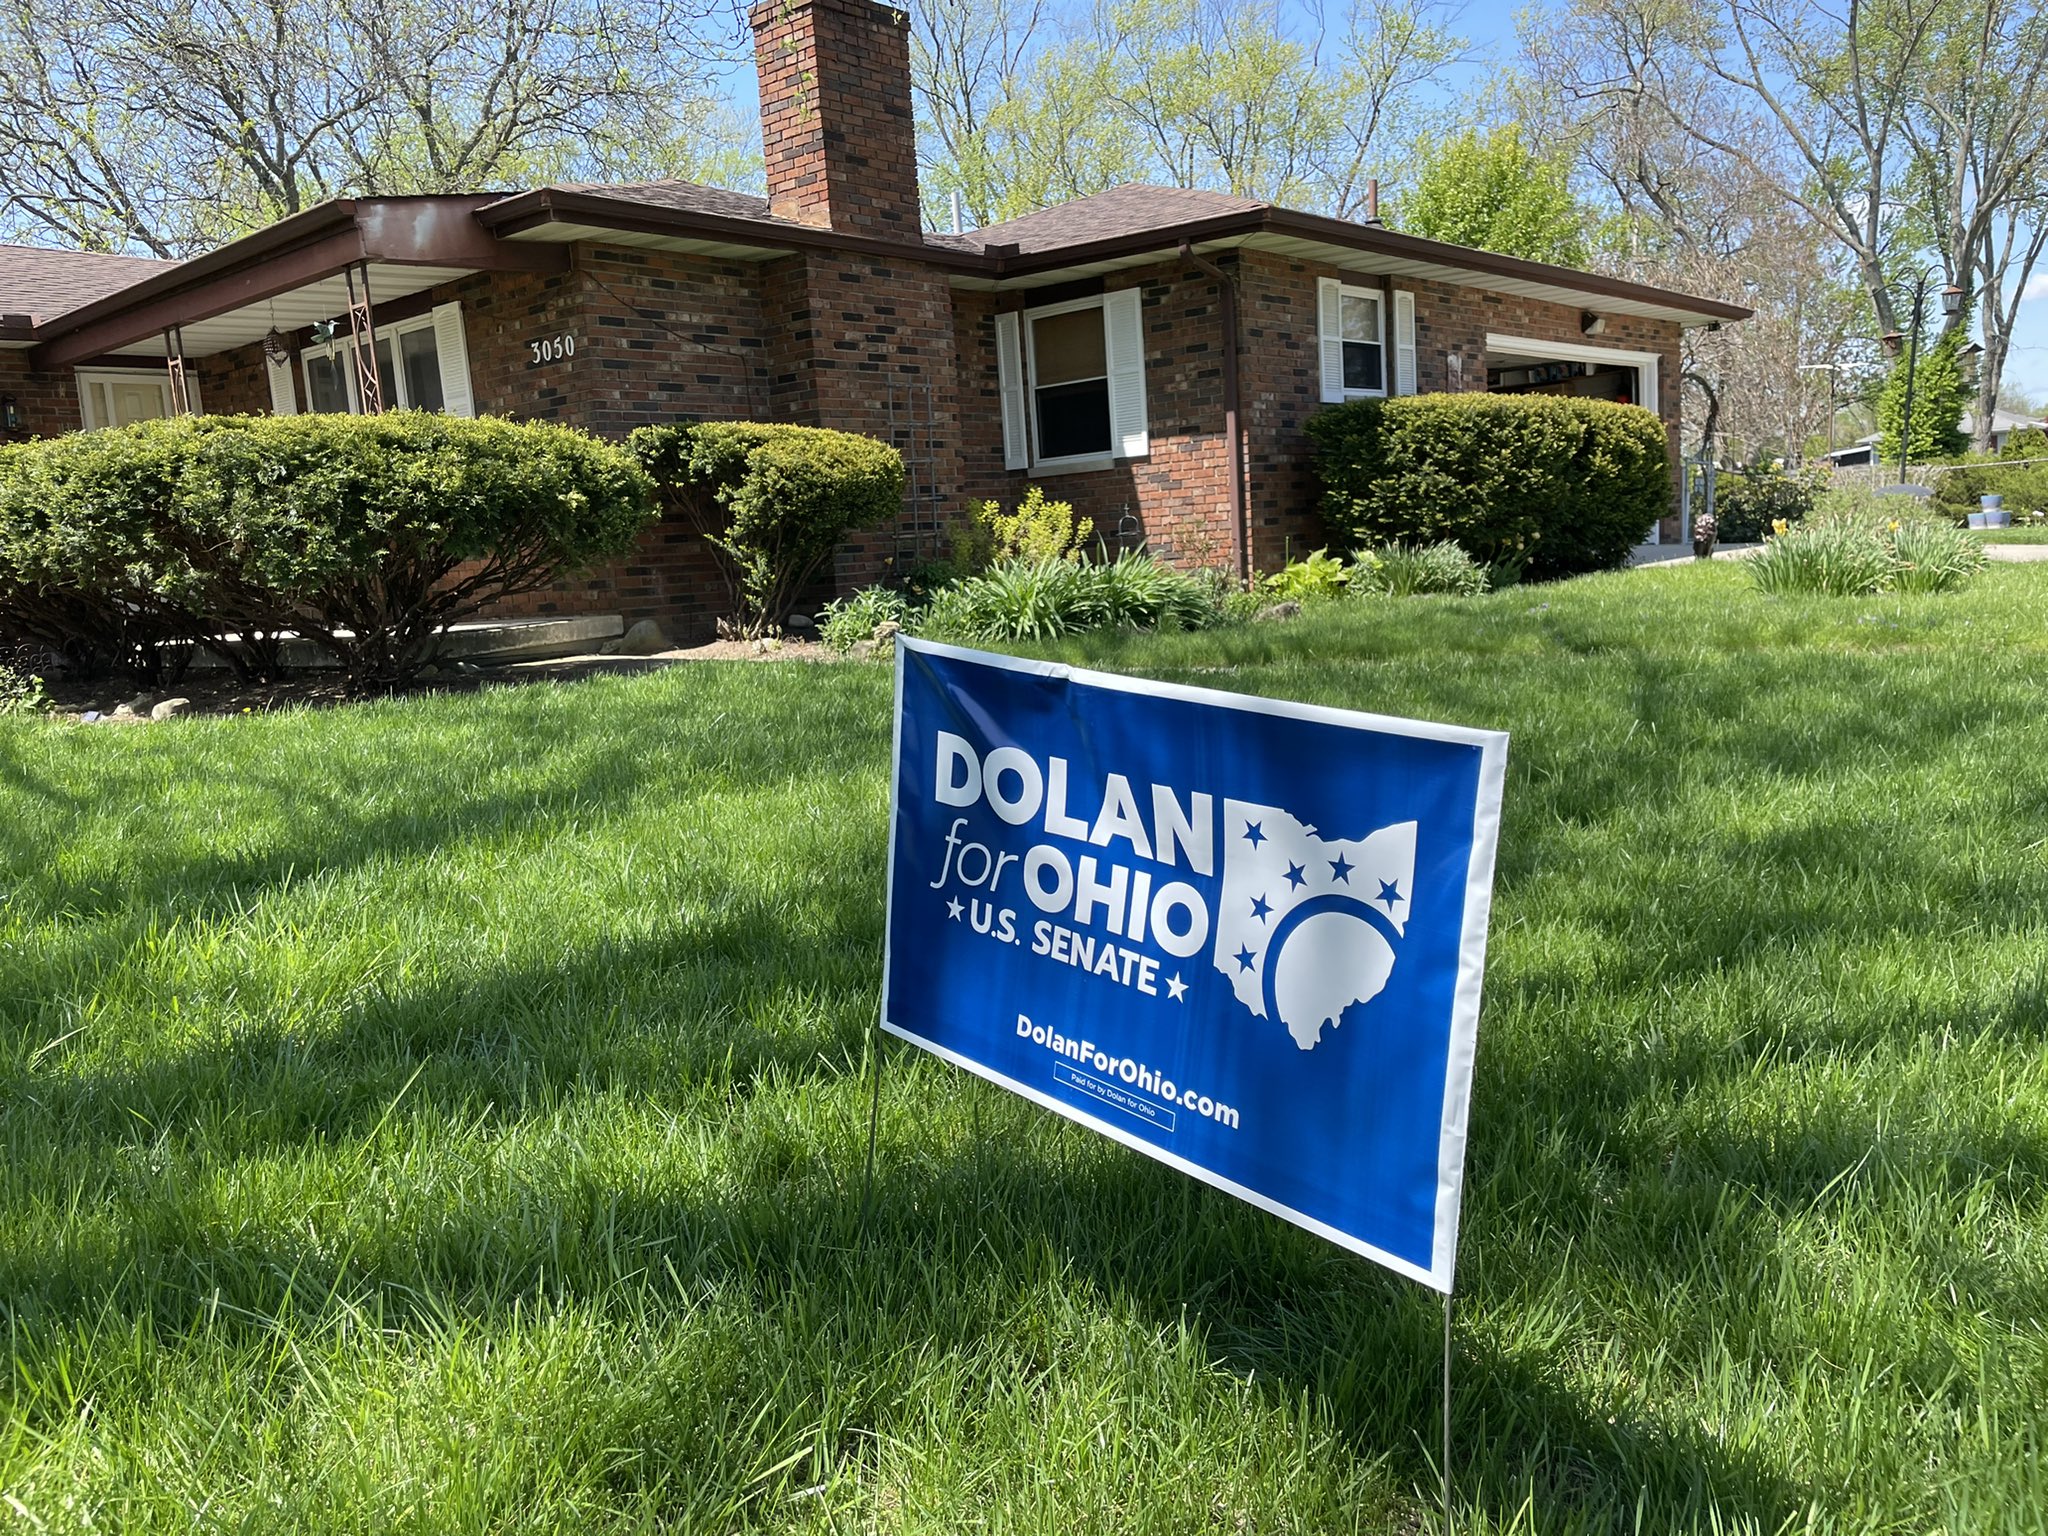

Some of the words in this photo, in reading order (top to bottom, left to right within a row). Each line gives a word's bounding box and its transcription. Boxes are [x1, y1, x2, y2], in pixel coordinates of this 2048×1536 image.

[531, 335, 574, 363] 3050
[935, 730, 1214, 877] DOLAN
[929, 818, 1019, 892] for
[1023, 844, 1210, 958] OHIO
[970, 898, 1021, 946] U.S.
[1031, 920, 1160, 997] SENATE
[1016, 1013, 1240, 1130] DolanForOhio.com
[1071, 1073, 1086, 1086] Paid
[1086, 1080, 1097, 1090] for
[1097, 1085, 1107, 1096] by
[1106, 1089, 1127, 1104] Dolan
[1127, 1097, 1138, 1109] for
[1138, 1103, 1156, 1117] Ohio
